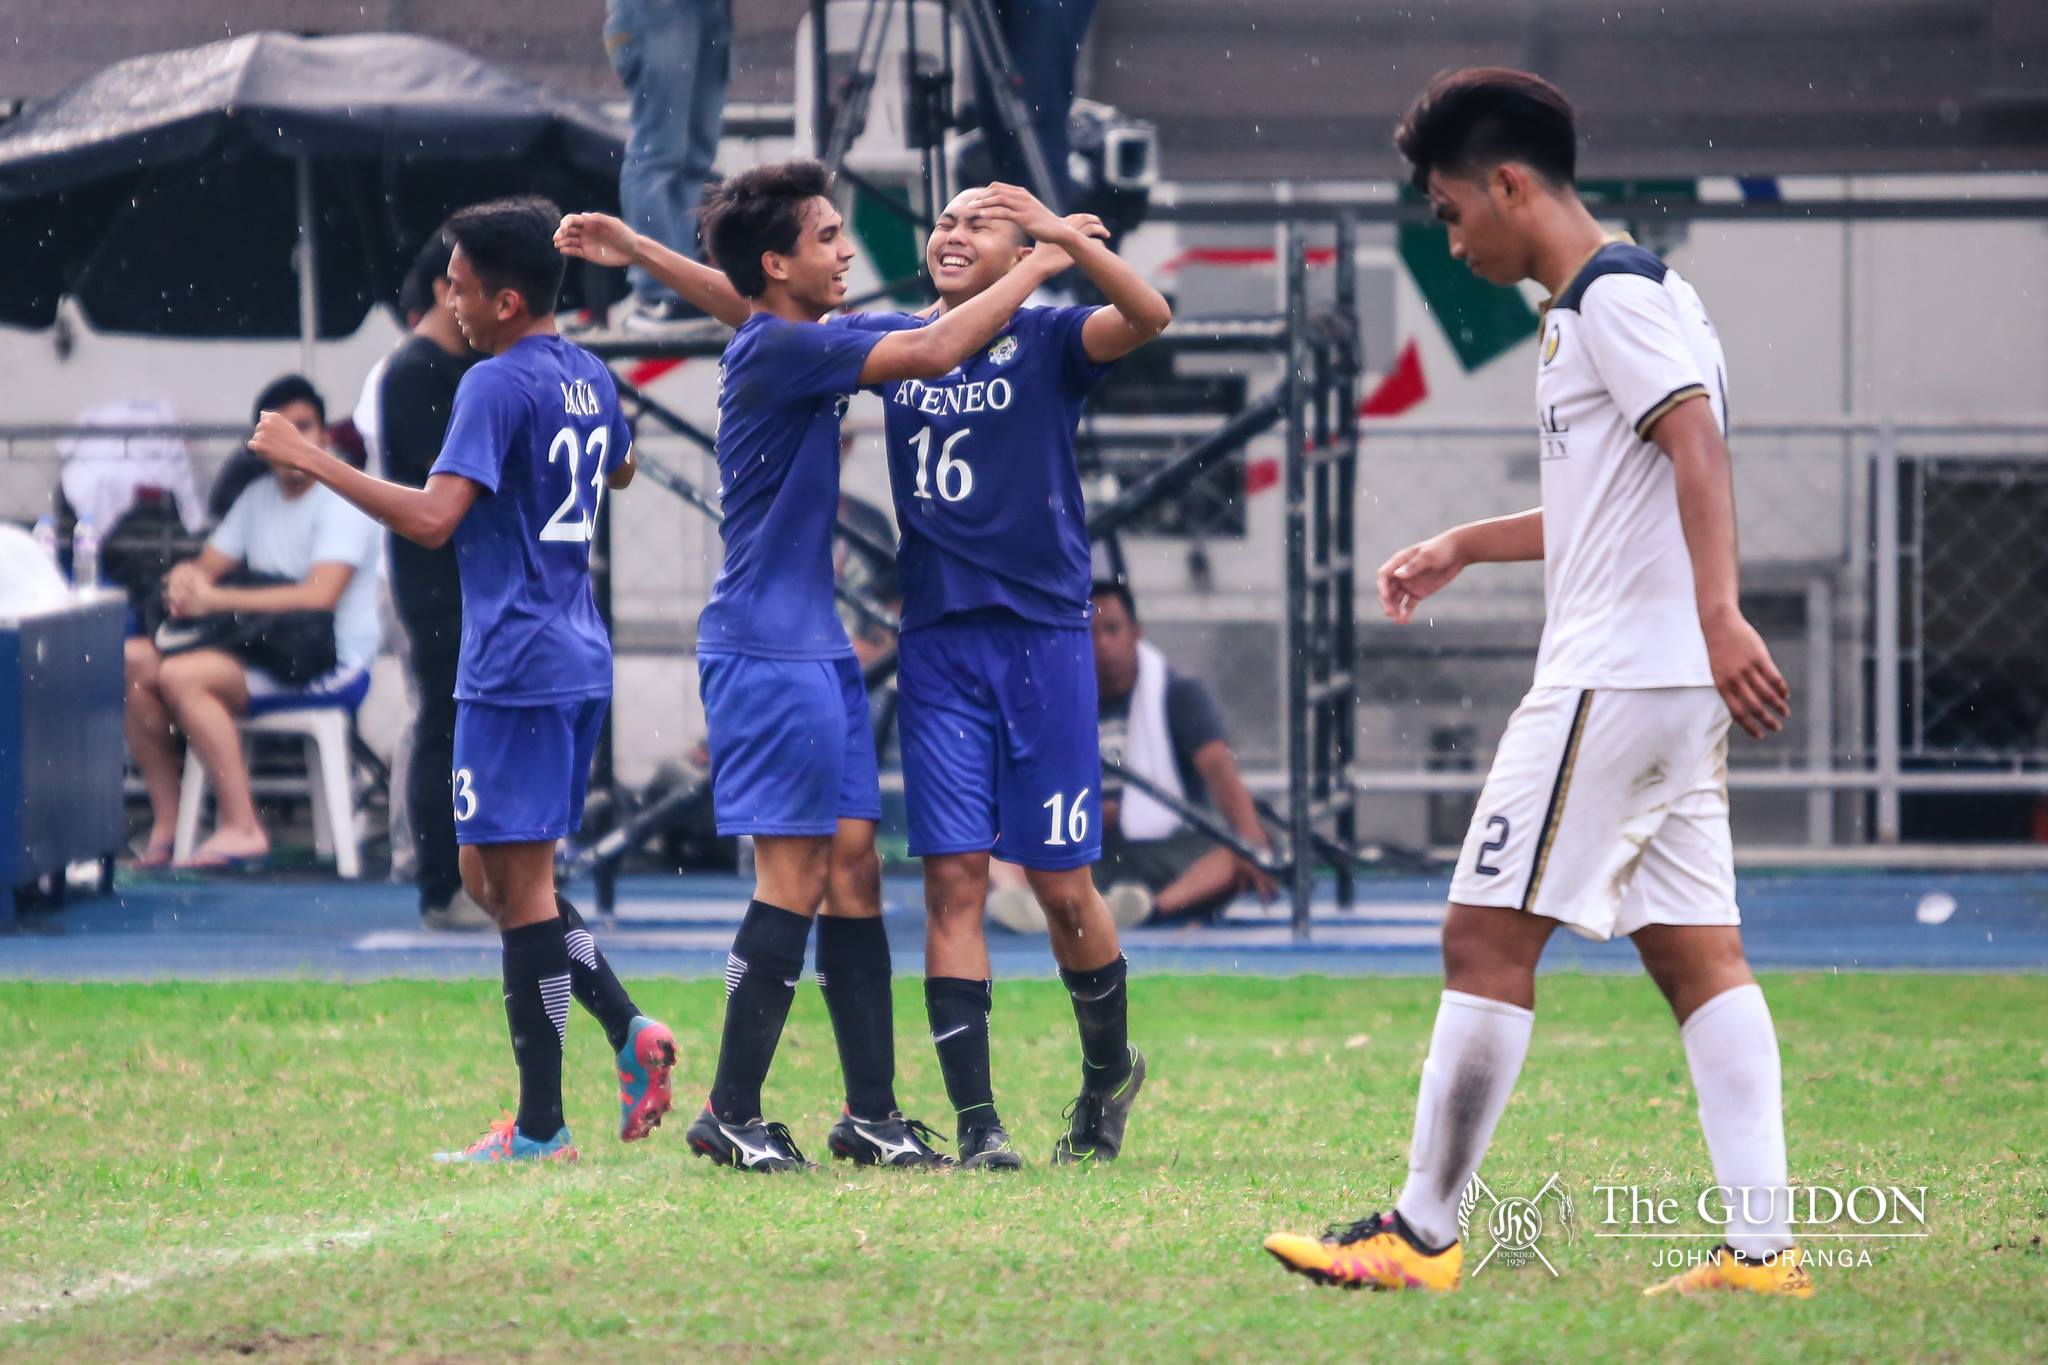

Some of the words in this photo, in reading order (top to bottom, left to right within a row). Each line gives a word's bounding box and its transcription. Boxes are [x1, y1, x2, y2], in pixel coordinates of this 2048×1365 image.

[893, 377, 1012, 416] ATENEO
[539, 427, 608, 542] 23
[908, 426, 973, 502] 16
[452, 768, 477, 822] 3
[1043, 788, 1089, 846] 16
[1475, 815, 1510, 876] 2
